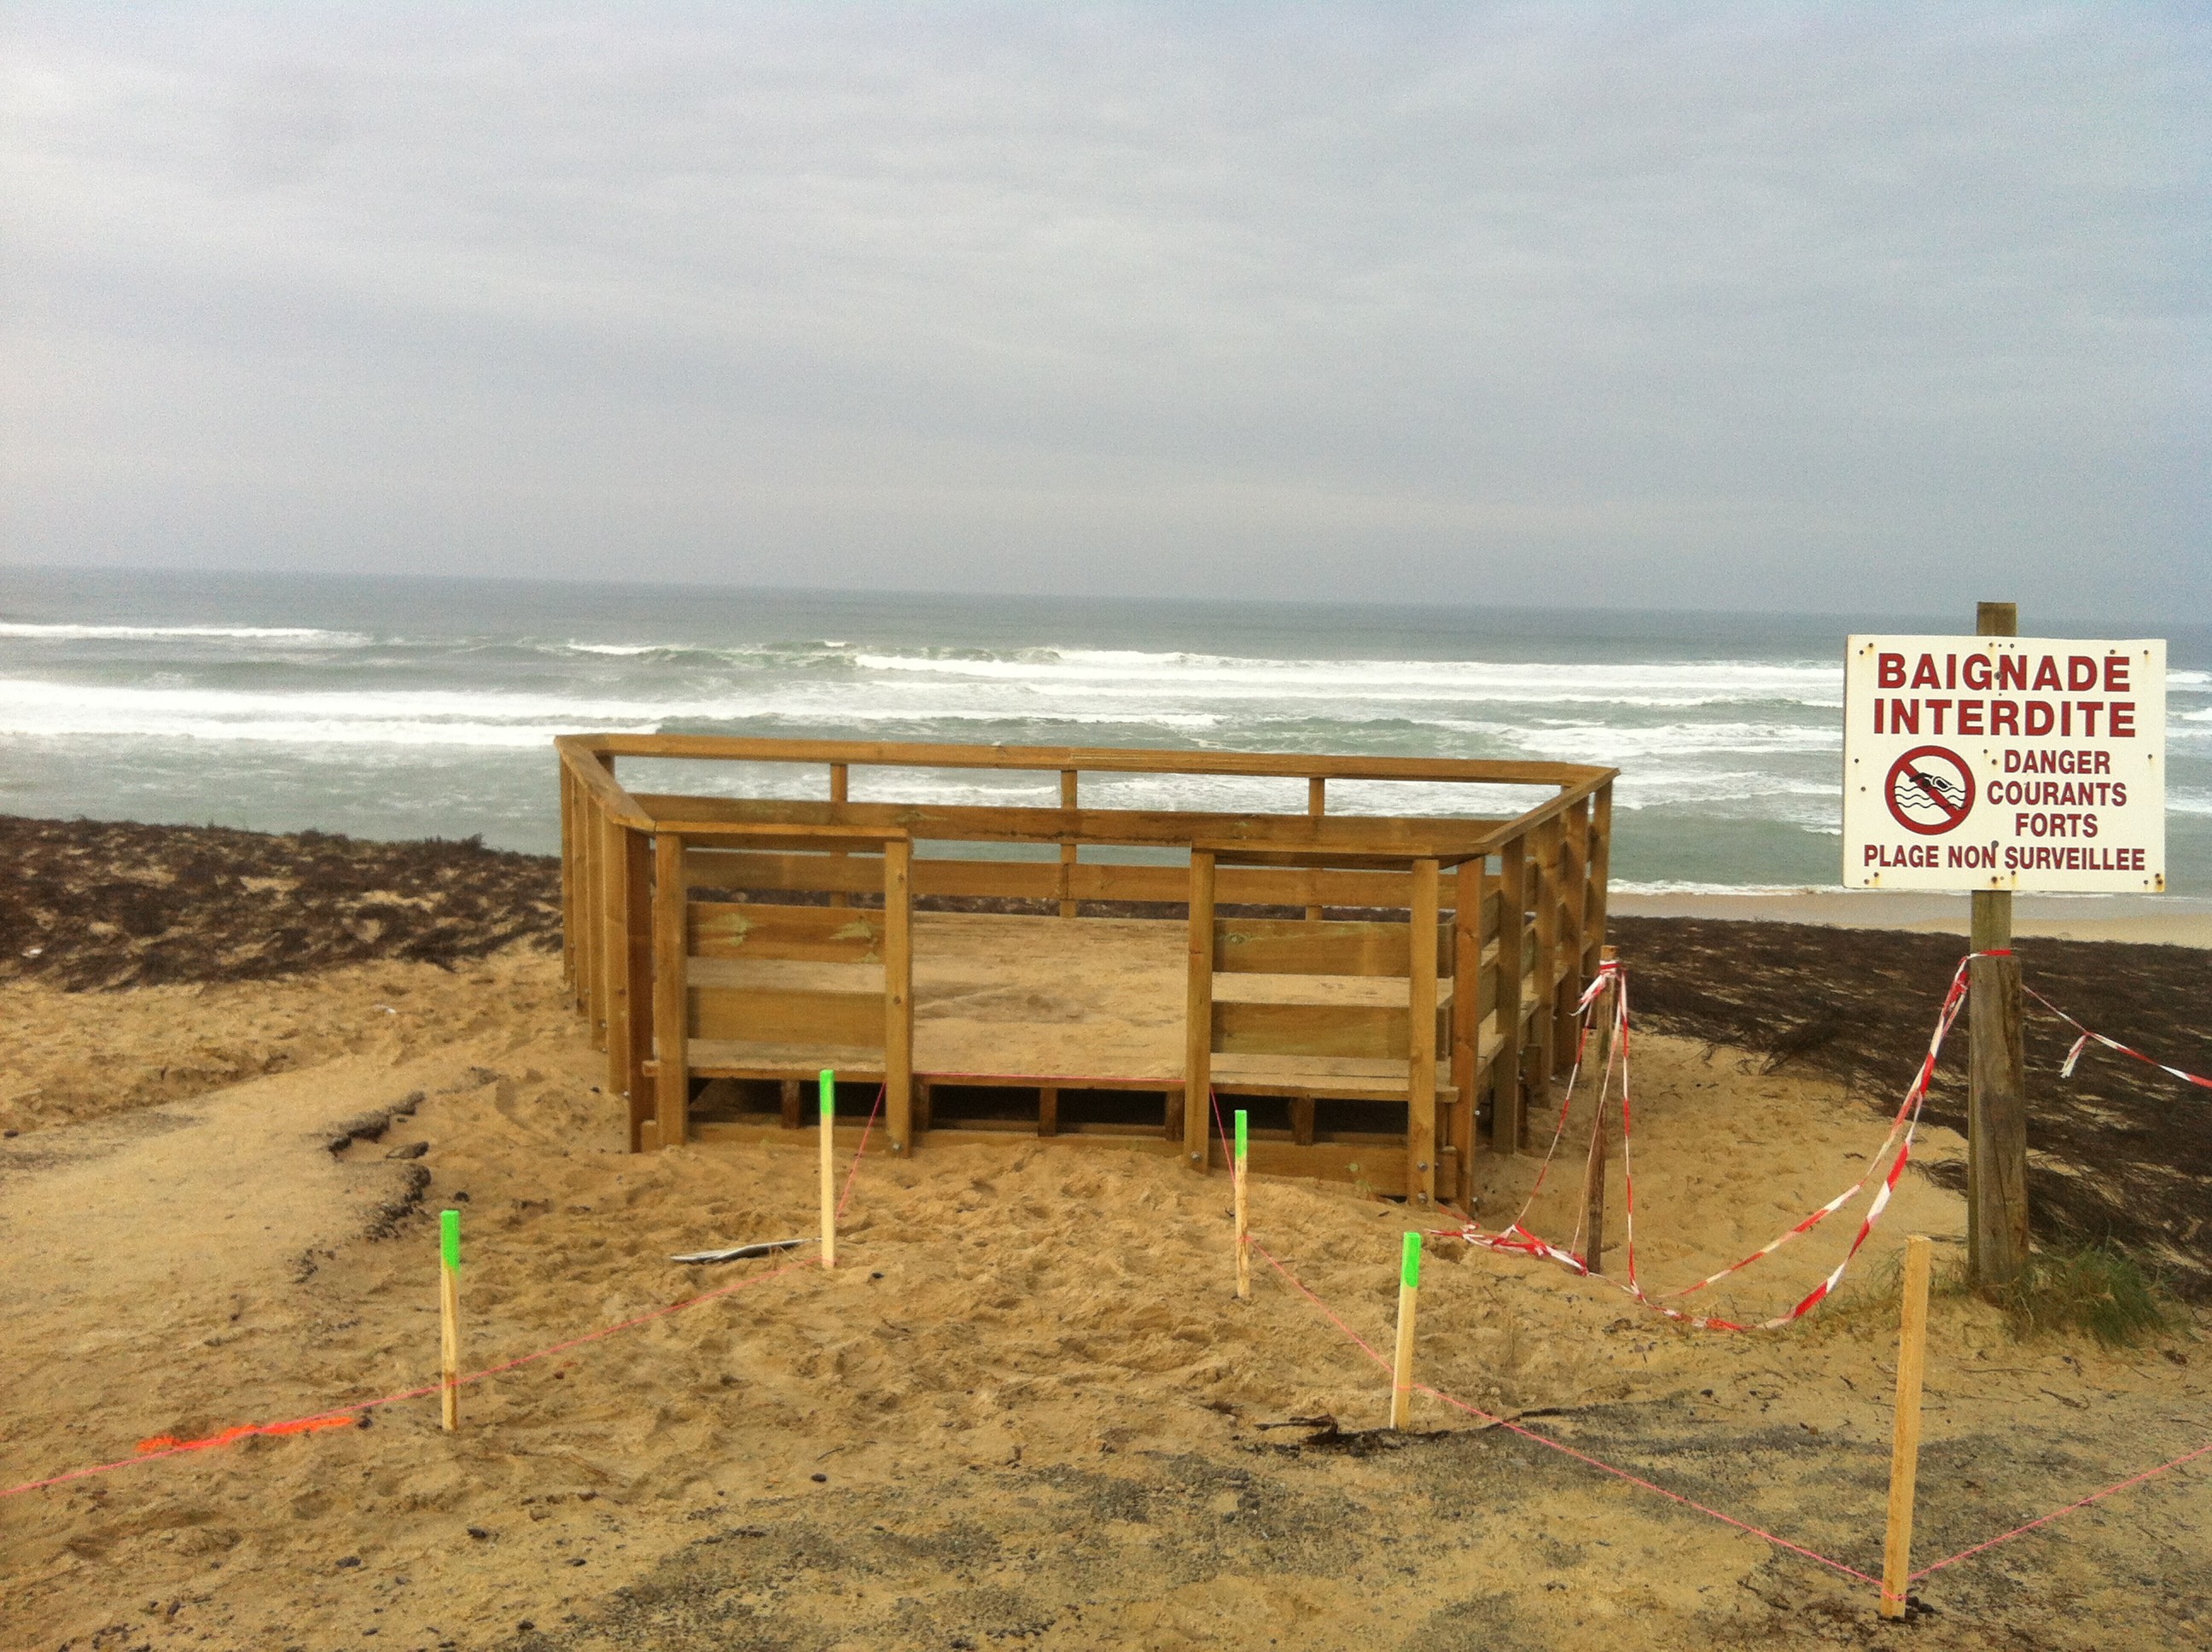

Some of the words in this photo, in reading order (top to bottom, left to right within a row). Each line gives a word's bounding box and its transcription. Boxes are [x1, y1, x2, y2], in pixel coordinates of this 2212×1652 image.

[1877, 653, 2130, 692] BAIGNADE
[1874, 698, 2135, 738] INTERDITE
[2004, 749, 2110, 775] DANGER
[1987, 780, 2127, 806] COURANTS
[2015, 812, 2098, 838] FORTS
[1864, 844, 1939, 868] PLAGE
[1947, 846, 1997, 869] NON
[2004, 846, 2145, 871] SURVEILLEE
